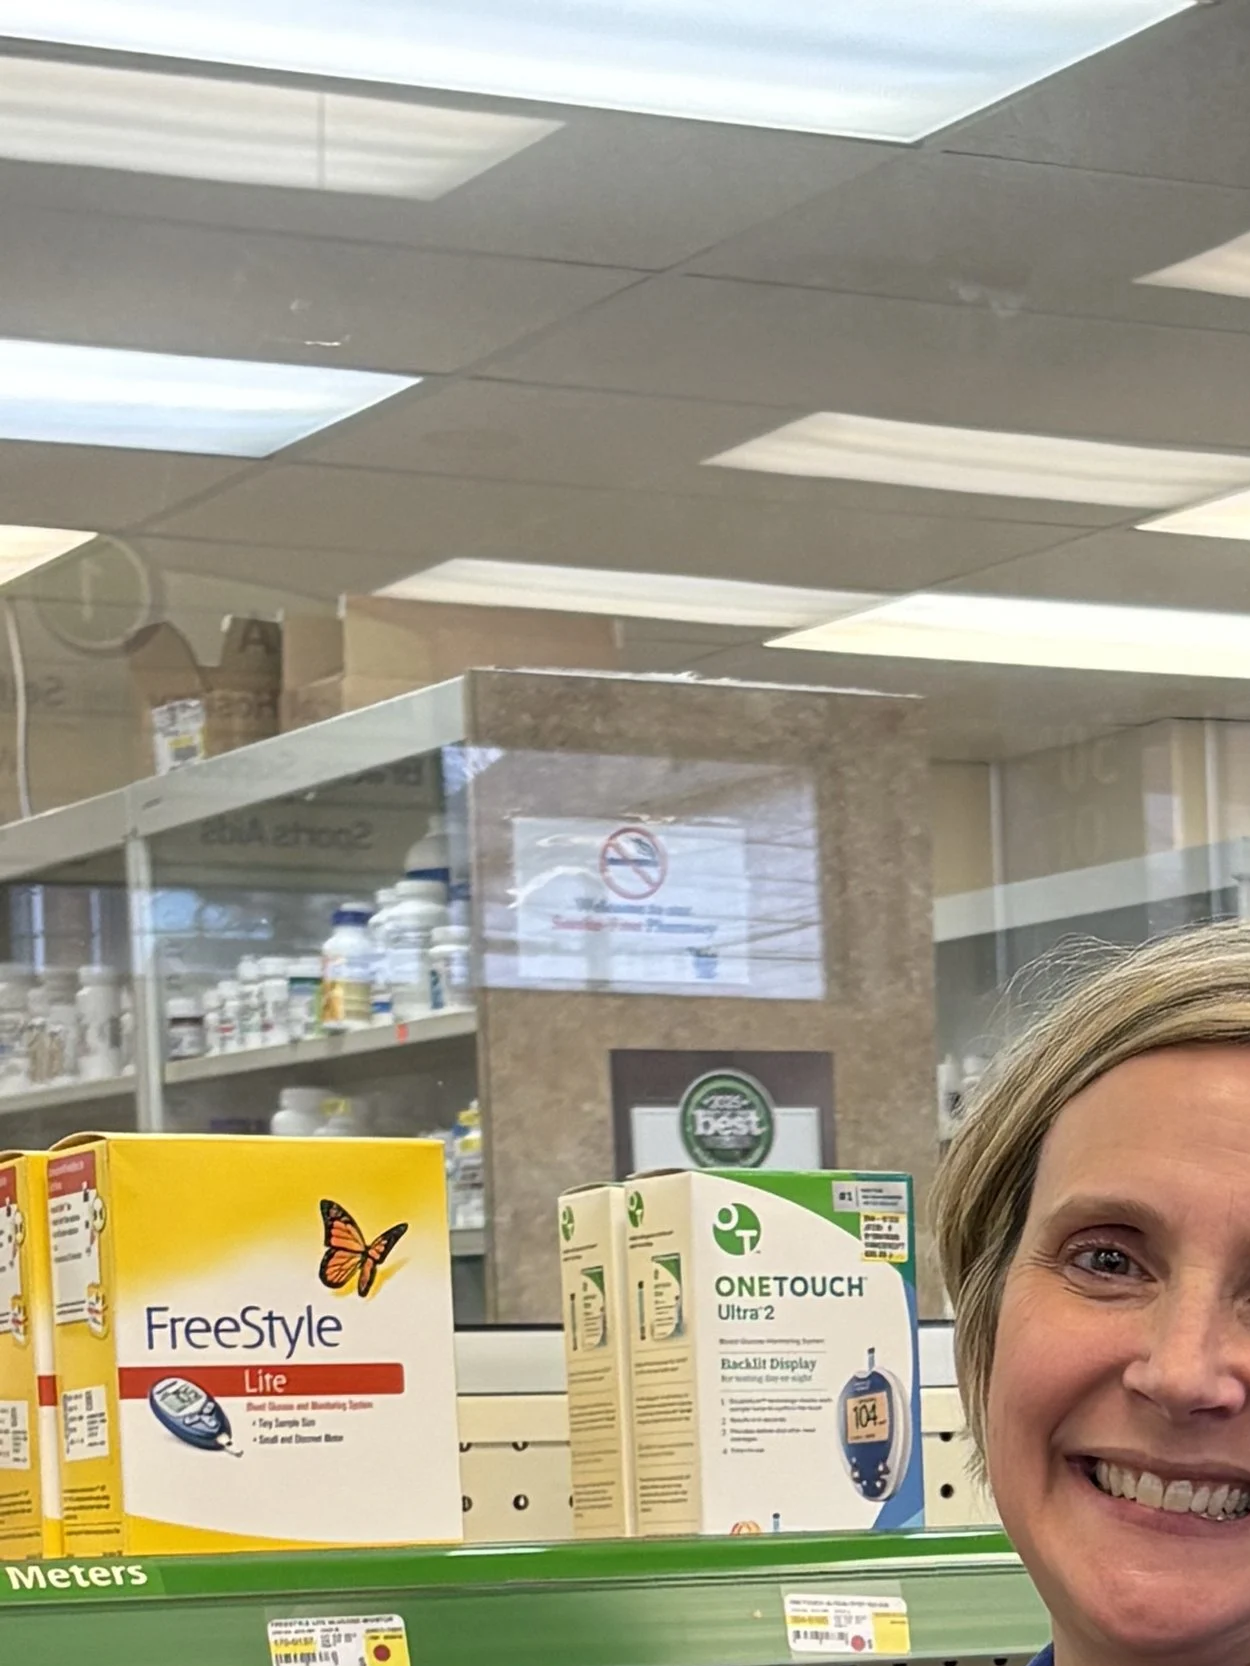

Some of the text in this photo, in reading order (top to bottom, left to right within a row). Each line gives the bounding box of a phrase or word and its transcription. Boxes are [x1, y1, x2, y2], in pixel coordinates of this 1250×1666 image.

[715, 1276, 865, 1298] ONETOUCH
[146, 1305, 343, 1360] FreeStyle
[721, 1356, 817, 1373] Backlit Display
[243, 1369, 288, 1394] Lite
[853, 1403, 878, 1431] 104
[5, 1563, 148, 1590] Meters
